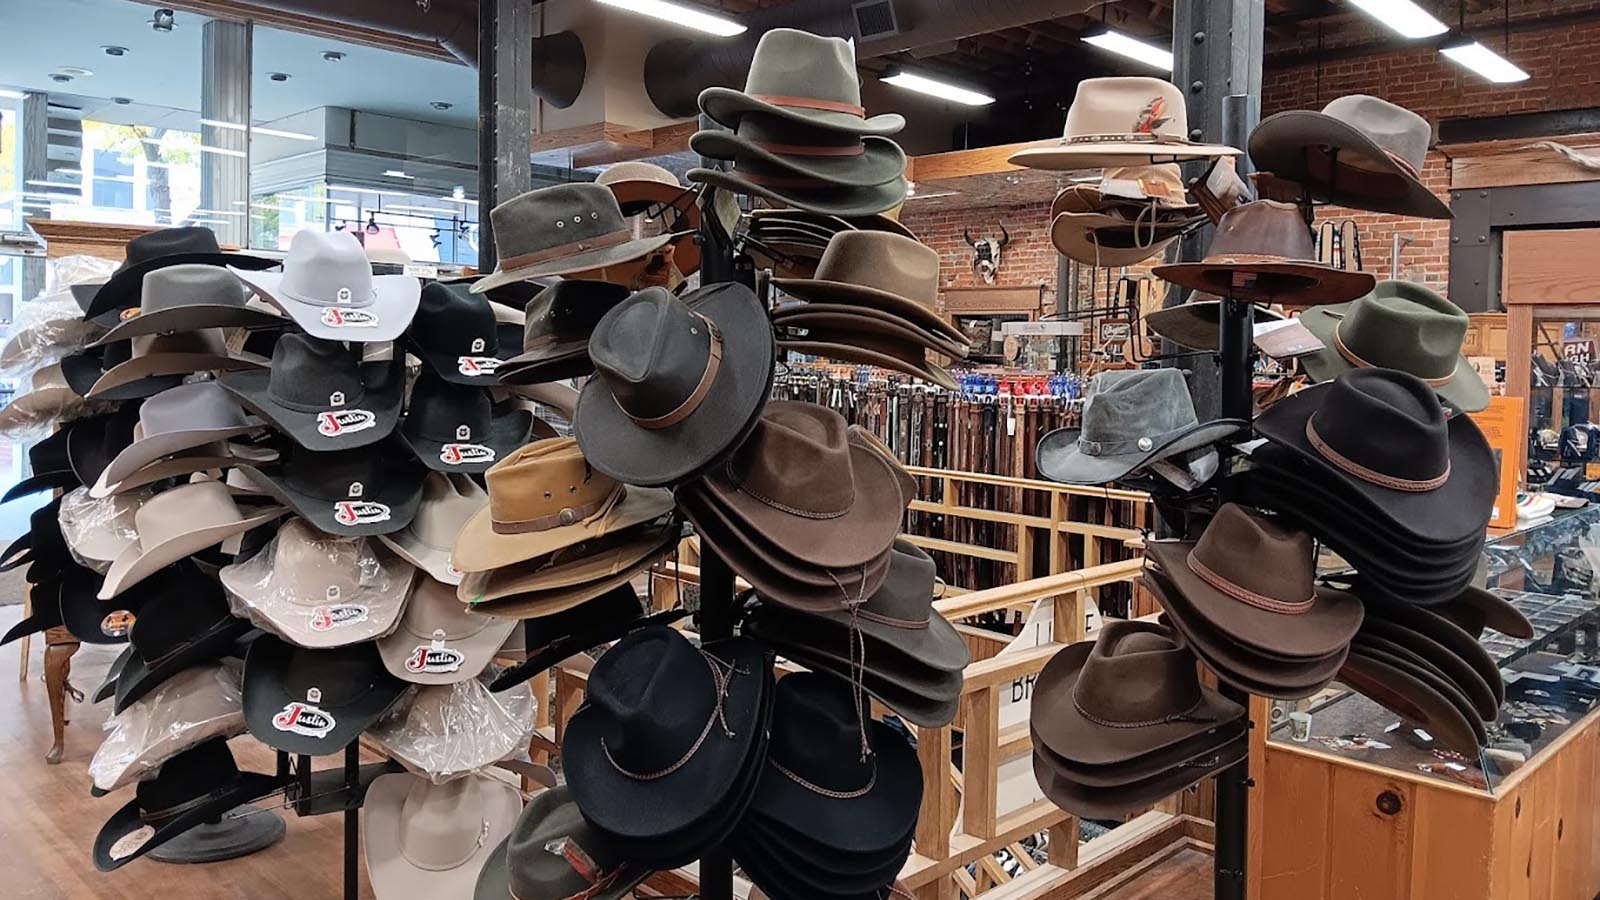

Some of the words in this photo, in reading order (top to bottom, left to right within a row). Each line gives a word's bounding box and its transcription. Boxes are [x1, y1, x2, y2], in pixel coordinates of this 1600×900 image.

[324, 308, 373, 325] Justin
[321, 412, 368, 433] Justin
[443, 445, 489, 462] Justin
[338, 502, 383, 523] Justin
[312, 606, 362, 628] Justin
[408, 648, 457, 669] Justin
[277, 705, 328, 729] Justin
